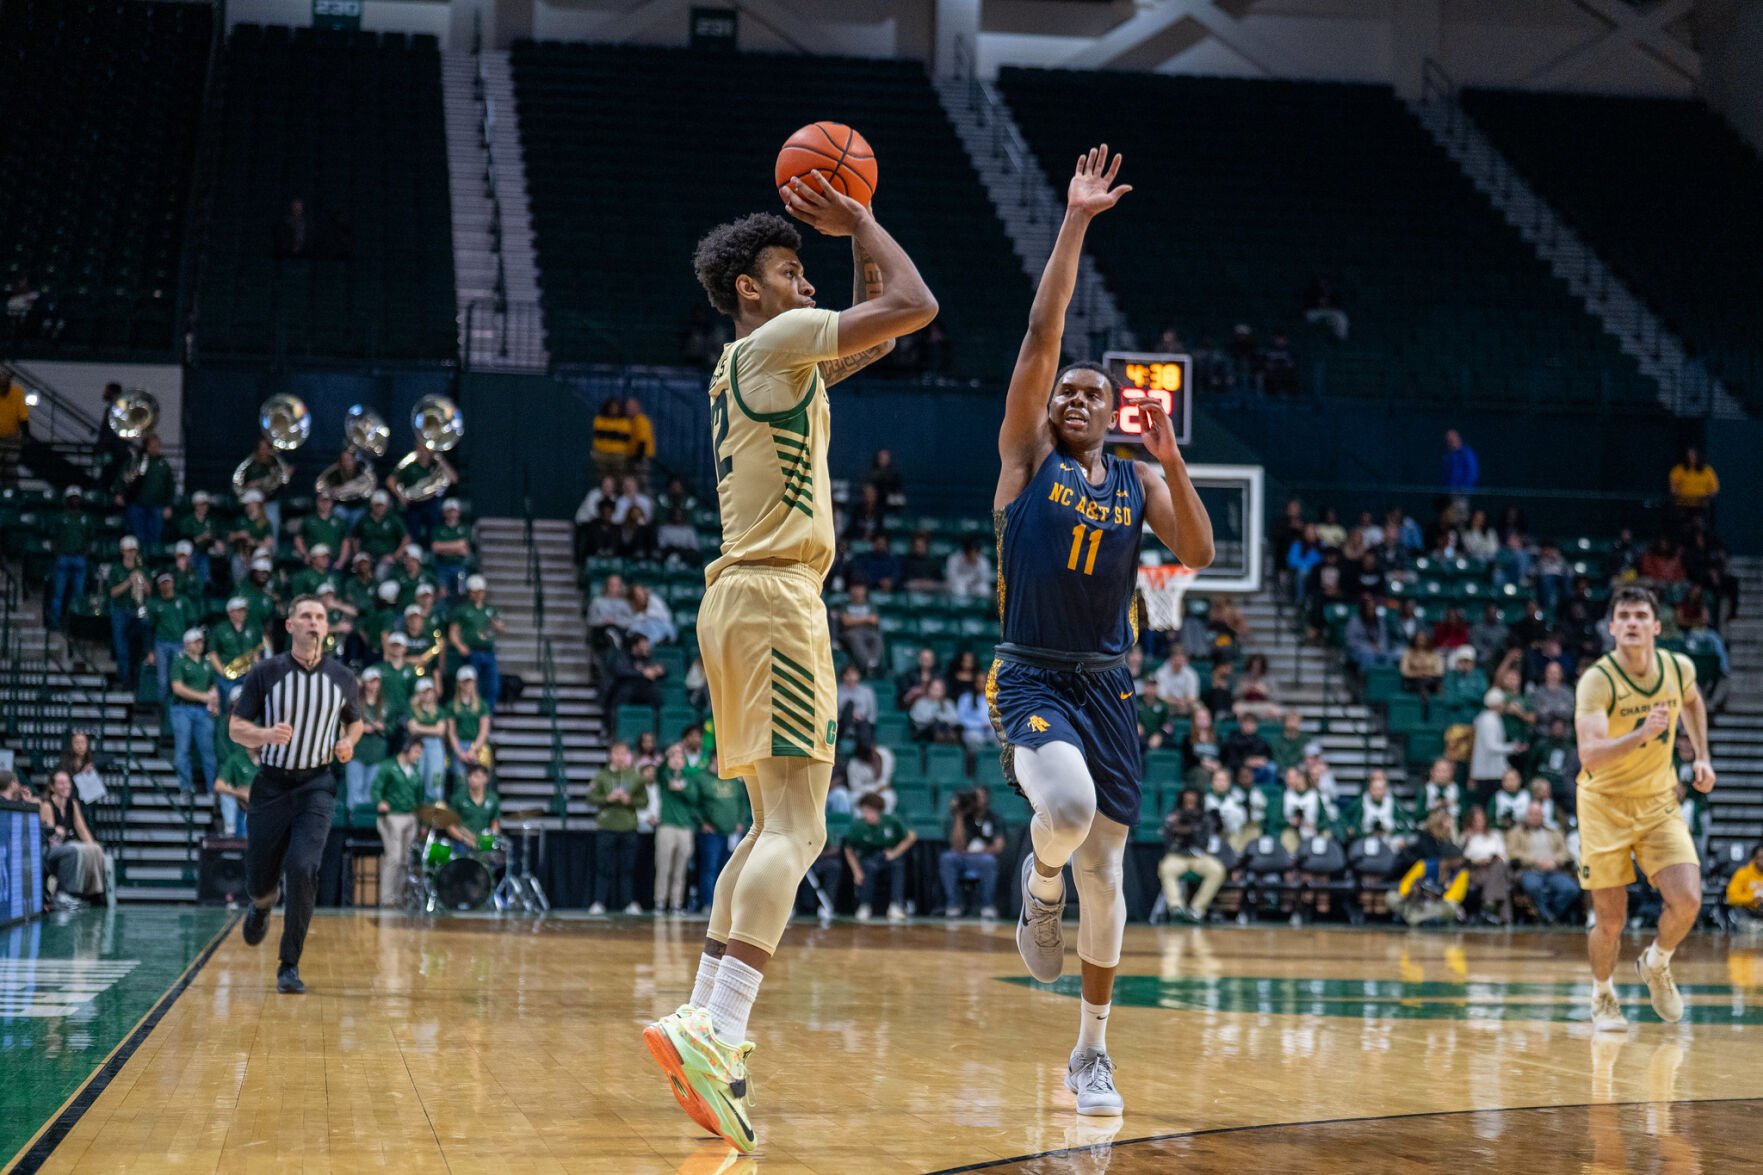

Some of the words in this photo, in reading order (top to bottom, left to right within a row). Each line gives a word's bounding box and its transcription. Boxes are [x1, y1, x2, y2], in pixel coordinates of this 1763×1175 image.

[1048, 482, 1074, 506] NC
[1075, 496, 1110, 522] A&T
[1114, 506, 1132, 527] SU
[1067, 523, 1104, 576] 11
